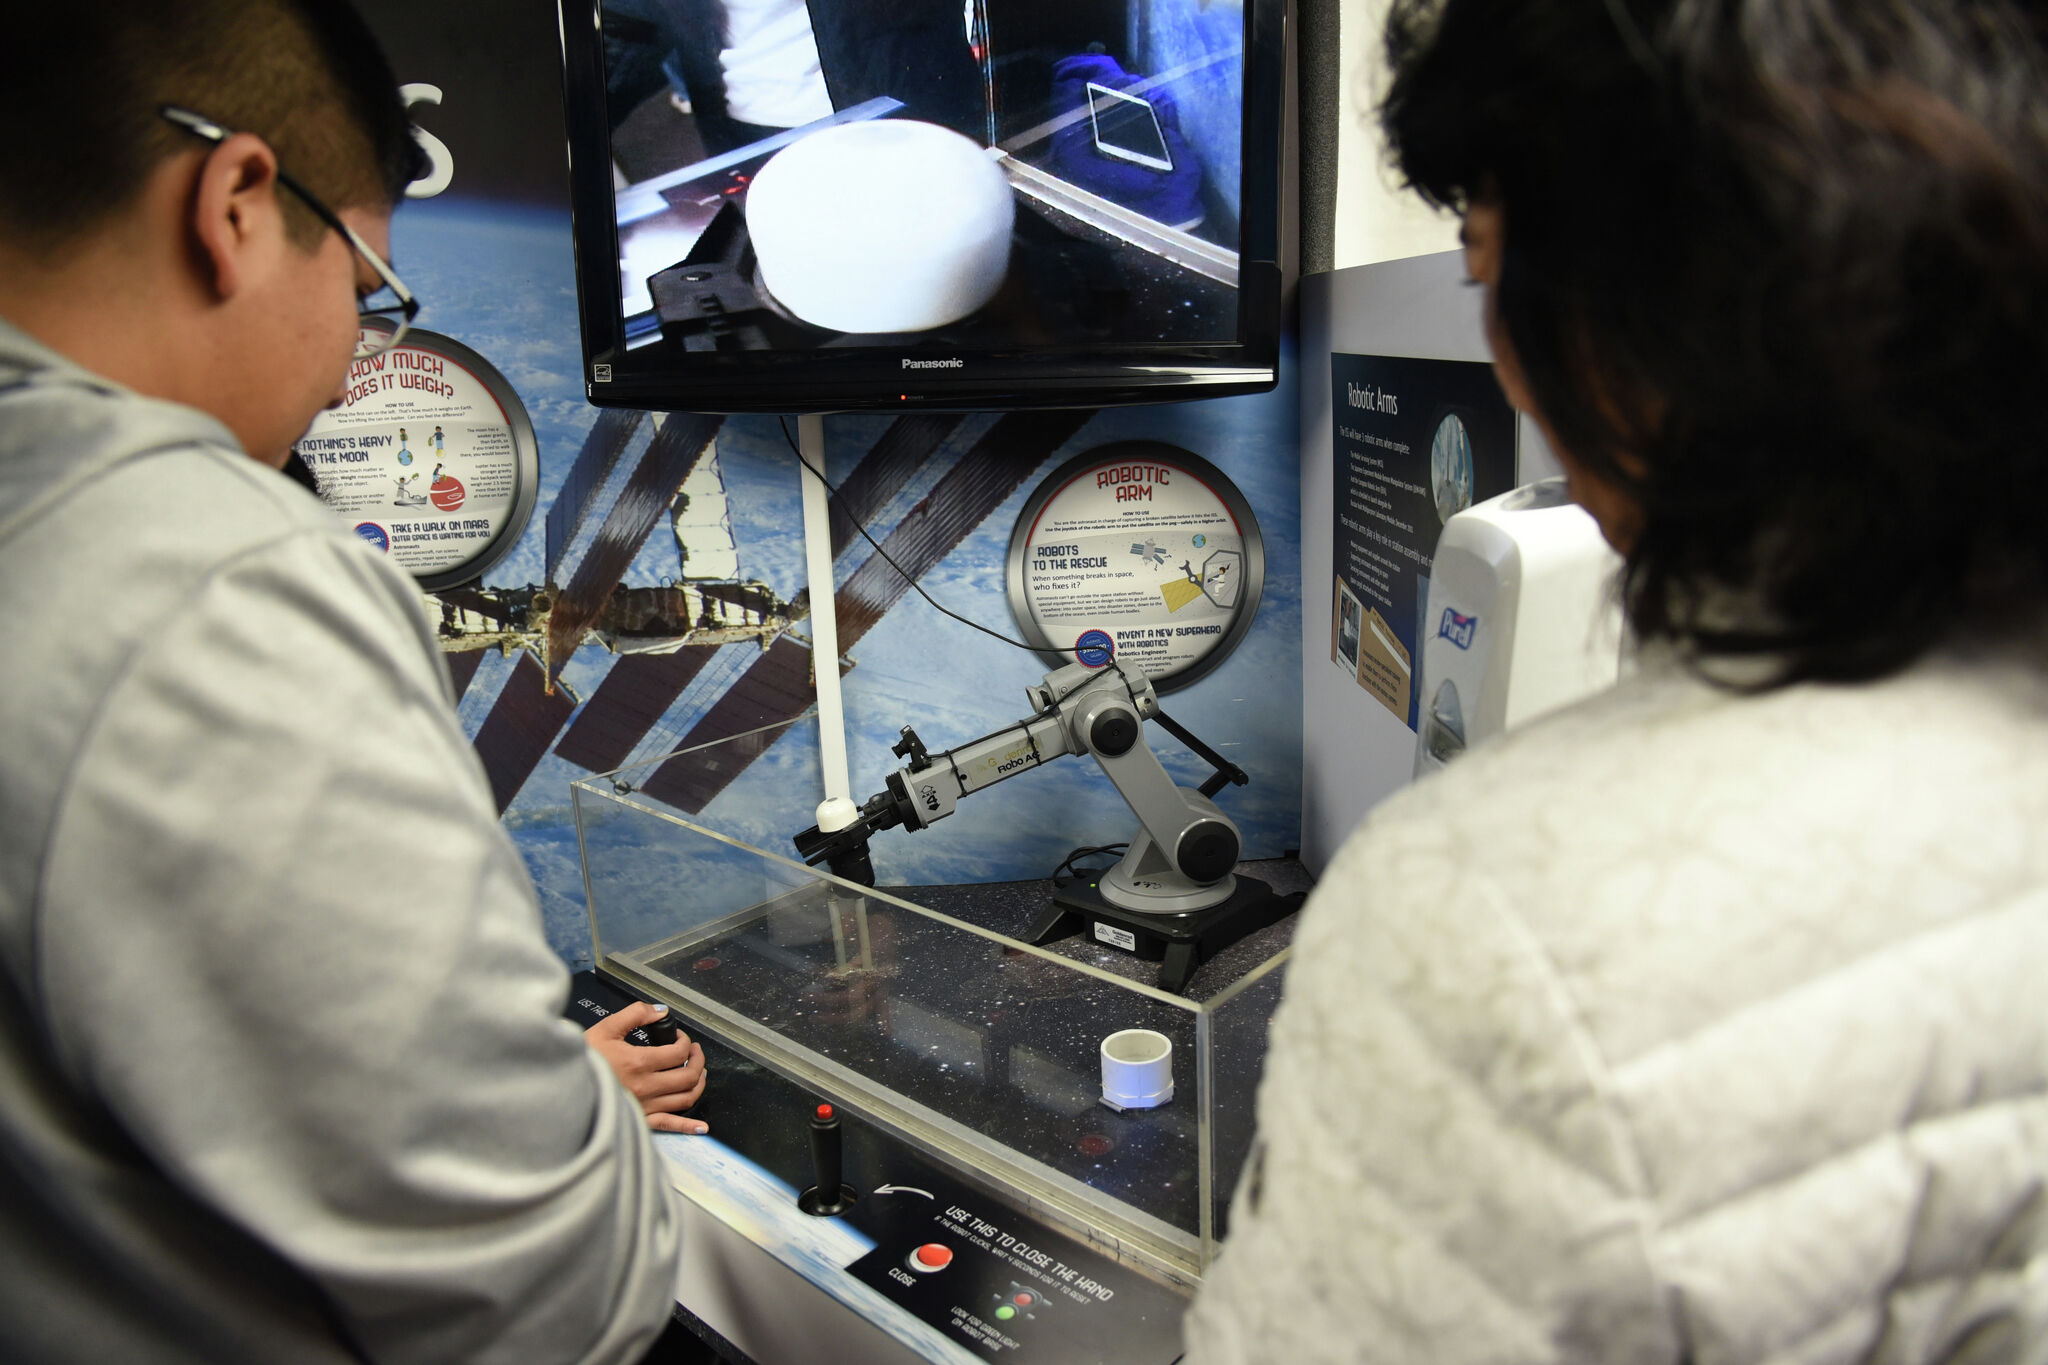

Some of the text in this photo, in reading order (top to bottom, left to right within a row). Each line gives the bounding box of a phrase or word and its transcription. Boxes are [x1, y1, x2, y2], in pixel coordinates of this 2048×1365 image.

[350, 352, 443, 381] HOW MUCH
[902, 357, 964, 369] Panasonic
[345, 373, 454, 407] DOES IT WEIGH?
[1348, 381, 1398, 415] Robotic Arms
[303, 435, 392, 451] NOTHING'S HEAVY
[302, 450, 369, 465] ON THE MOON
[1097, 465, 1170, 489] ROBOTIC
[1116, 485, 1152, 503] ARM
[391, 519, 490, 534] TAKE A WALK ON MARS
[391, 534, 411, 543] OUTER
[412, 533, 431, 542] SPACE
[432, 532, 438, 540] IS
[439, 531, 464, 540] WAITING
[465, 531, 477, 539] FOR
[478, 530, 491, 538] YOU
[1037, 545, 1079, 557] ROBOTS
[1032, 557, 1108, 571] TO THE RESCUE
[1052, 573, 1085, 581] something
[1086, 572, 1106, 580] breaks
[1114, 571, 1135, 579] space,
[1033, 583, 1051, 591] who
[1052, 582, 1069, 590] fixes
[1117, 625, 1222, 640] INVENT A NEW SUPERHERO
[1118, 639, 1169, 649] WITH ROBOTICS
[1141, 649, 1168, 657] Engineers
[998, 758, 1024, 774] Robo
[590, 1004, 610, 1017] THIS
[945, 1205, 1115, 1302] USE THIS TO CLOSE THE HAND
[940, 1218, 953, 1228] THE
[950, 1223, 972, 1238] ROBOT
[1011, 1258, 1042, 1278] SECONDS
[1040, 1274, 1055, 1285] FOR
[1060, 1285, 1071, 1294] TO
[1069, 1290, 1092, 1305] RESET
[888, 1267, 917, 1288] CLOSE
[950, 1305, 971, 1319] LOOK
[968, 1315, 983, 1327] FOR
[961, 1325, 986, 1341] ROBOT
